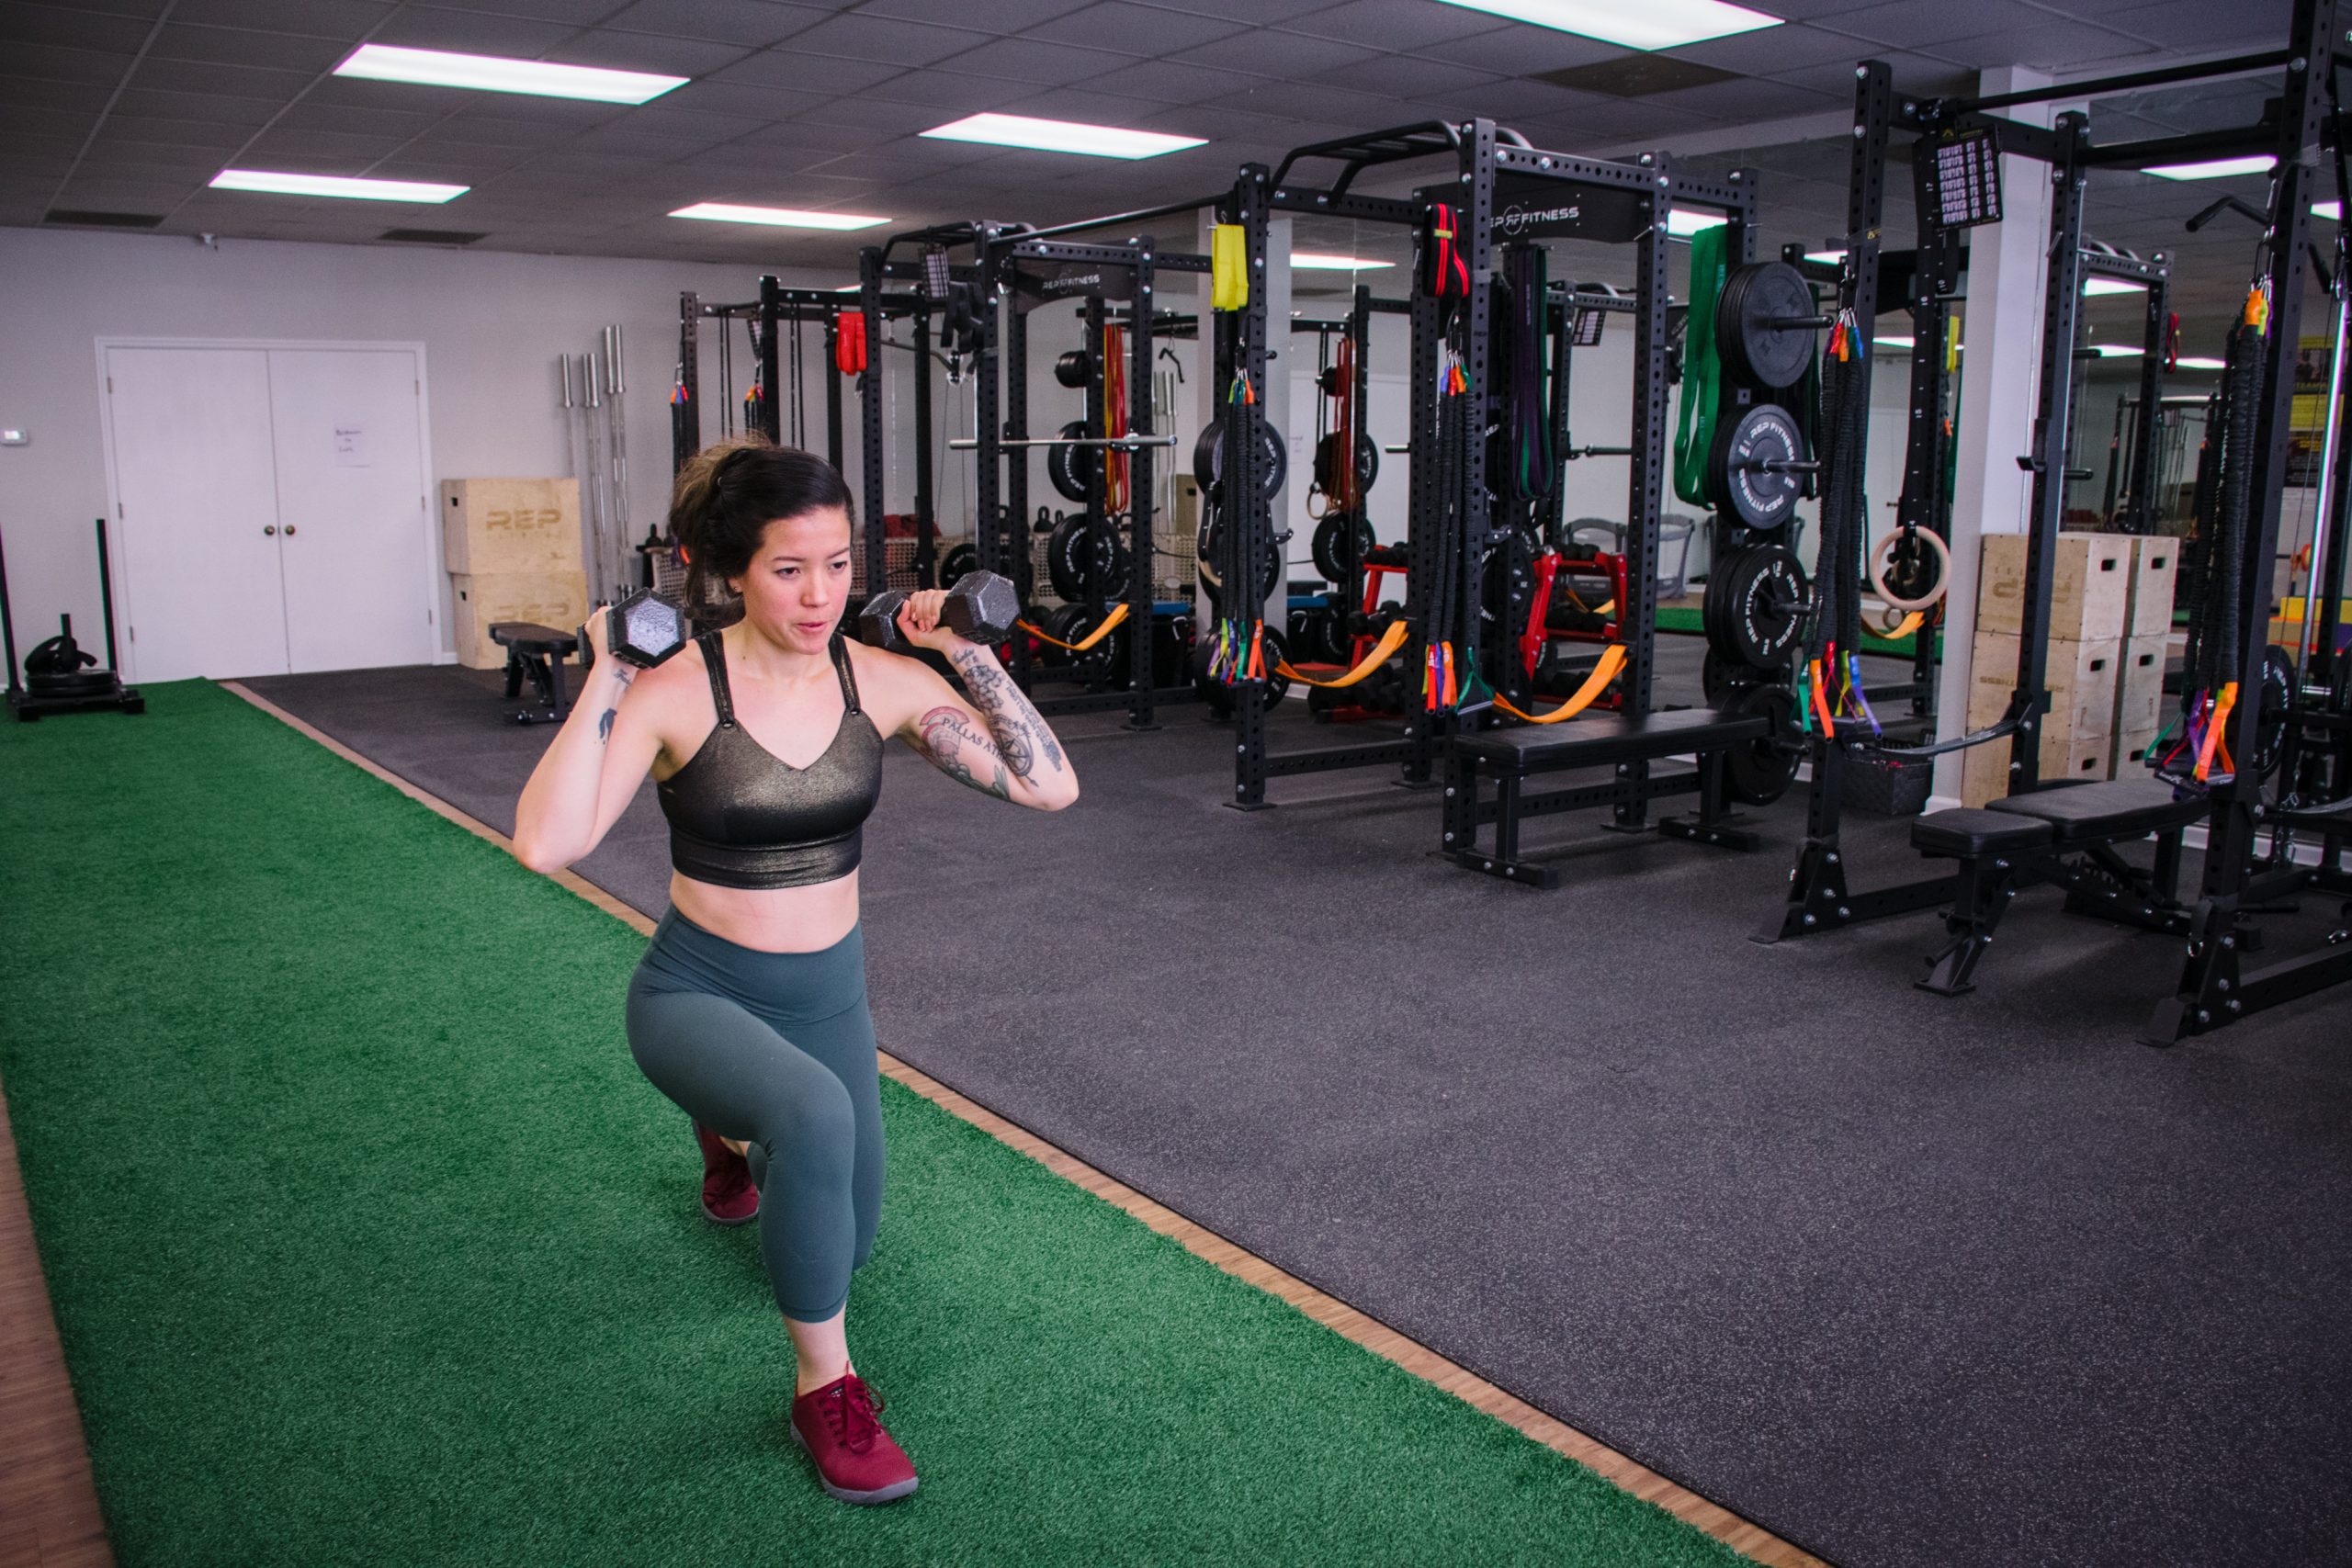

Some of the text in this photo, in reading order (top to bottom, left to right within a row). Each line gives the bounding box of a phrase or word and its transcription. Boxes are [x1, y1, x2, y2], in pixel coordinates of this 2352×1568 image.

[1521, 207, 1579, 224] FITNESS
[1068, 275, 1100, 287] FITNESS
[1749, 422, 1795, 461] REP FITNES
[1738, 468, 1765, 513] FITNESS
[1764, 494, 1784, 513] REP
[486, 509, 562, 531] REP
[1745, 568, 1770, 643] REP FITNESS
[941, 717, 984, 745] PALLAS
